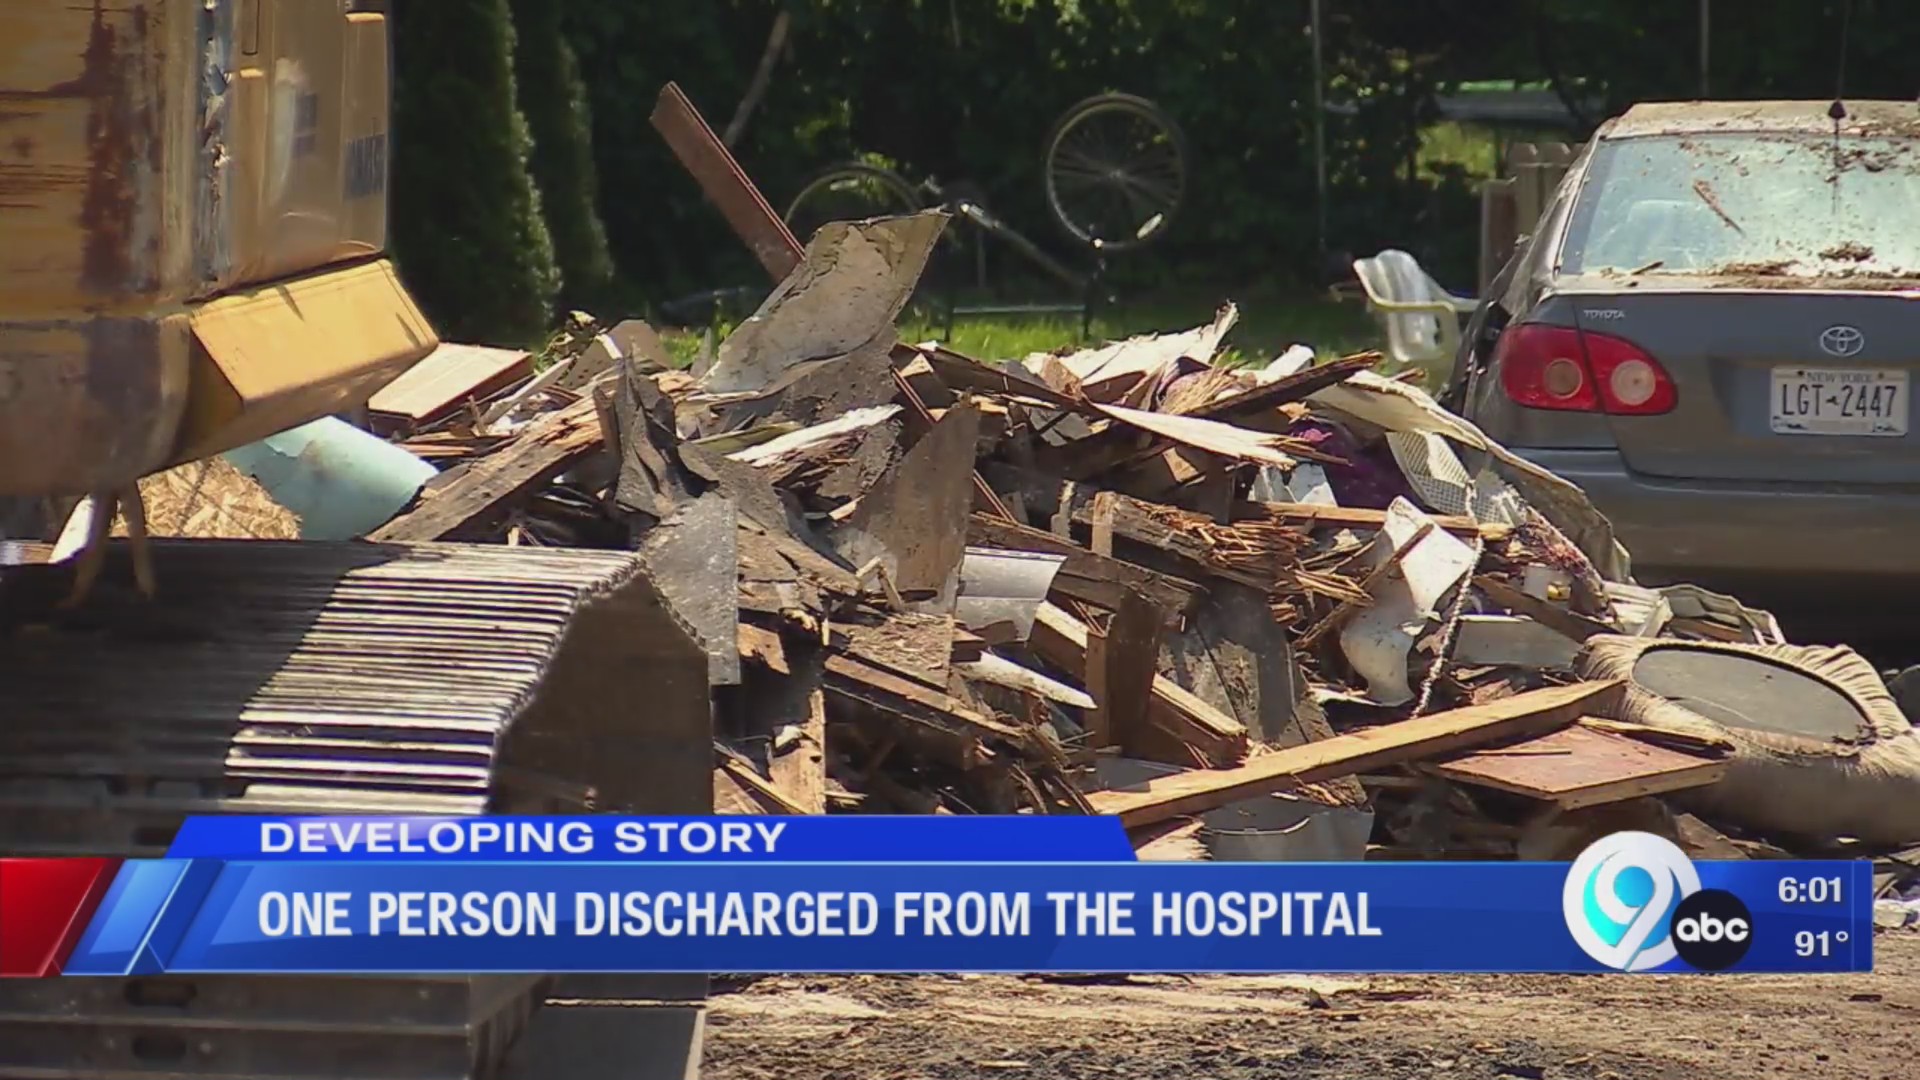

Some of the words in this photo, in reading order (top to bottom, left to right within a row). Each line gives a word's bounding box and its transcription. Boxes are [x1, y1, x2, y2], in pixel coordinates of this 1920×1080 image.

[1583, 309, 1625, 319] TOYOTA
[1807, 371, 1835, 382] NEW
[1840, 372, 1873, 382] YORK
